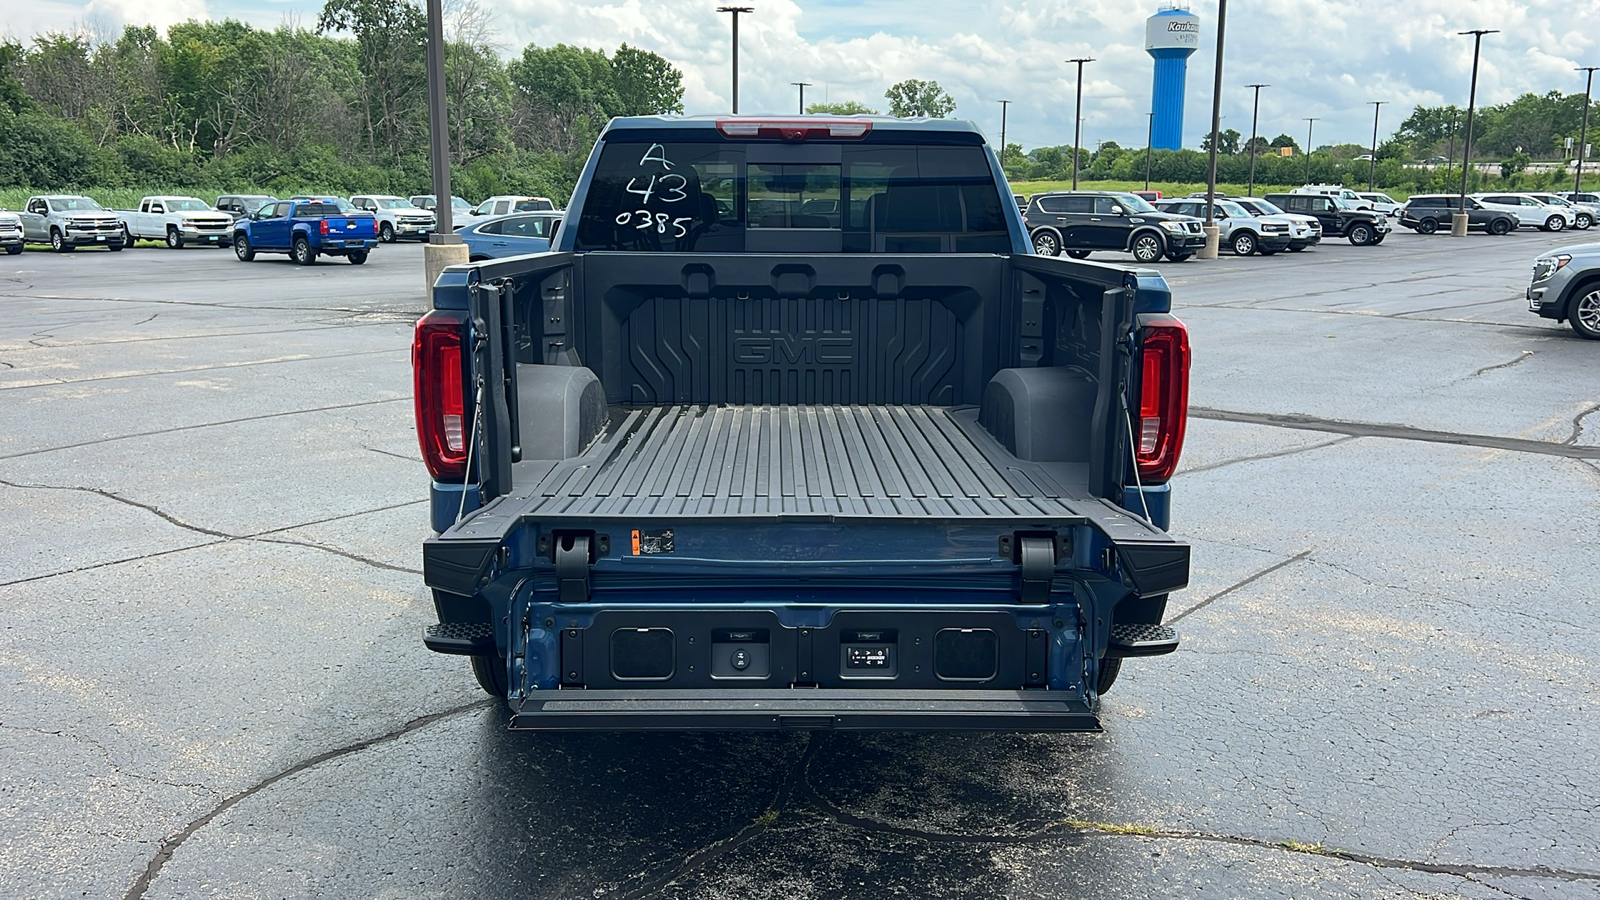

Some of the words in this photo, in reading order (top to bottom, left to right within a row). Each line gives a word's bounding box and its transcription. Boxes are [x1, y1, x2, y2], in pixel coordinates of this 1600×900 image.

[1168, 21, 1199, 32] Kauka
[639, 142, 676, 171] A
[626, 174, 687, 204] 43
[615, 209, 692, 238] 0385
[733, 337, 852, 364] GMC
